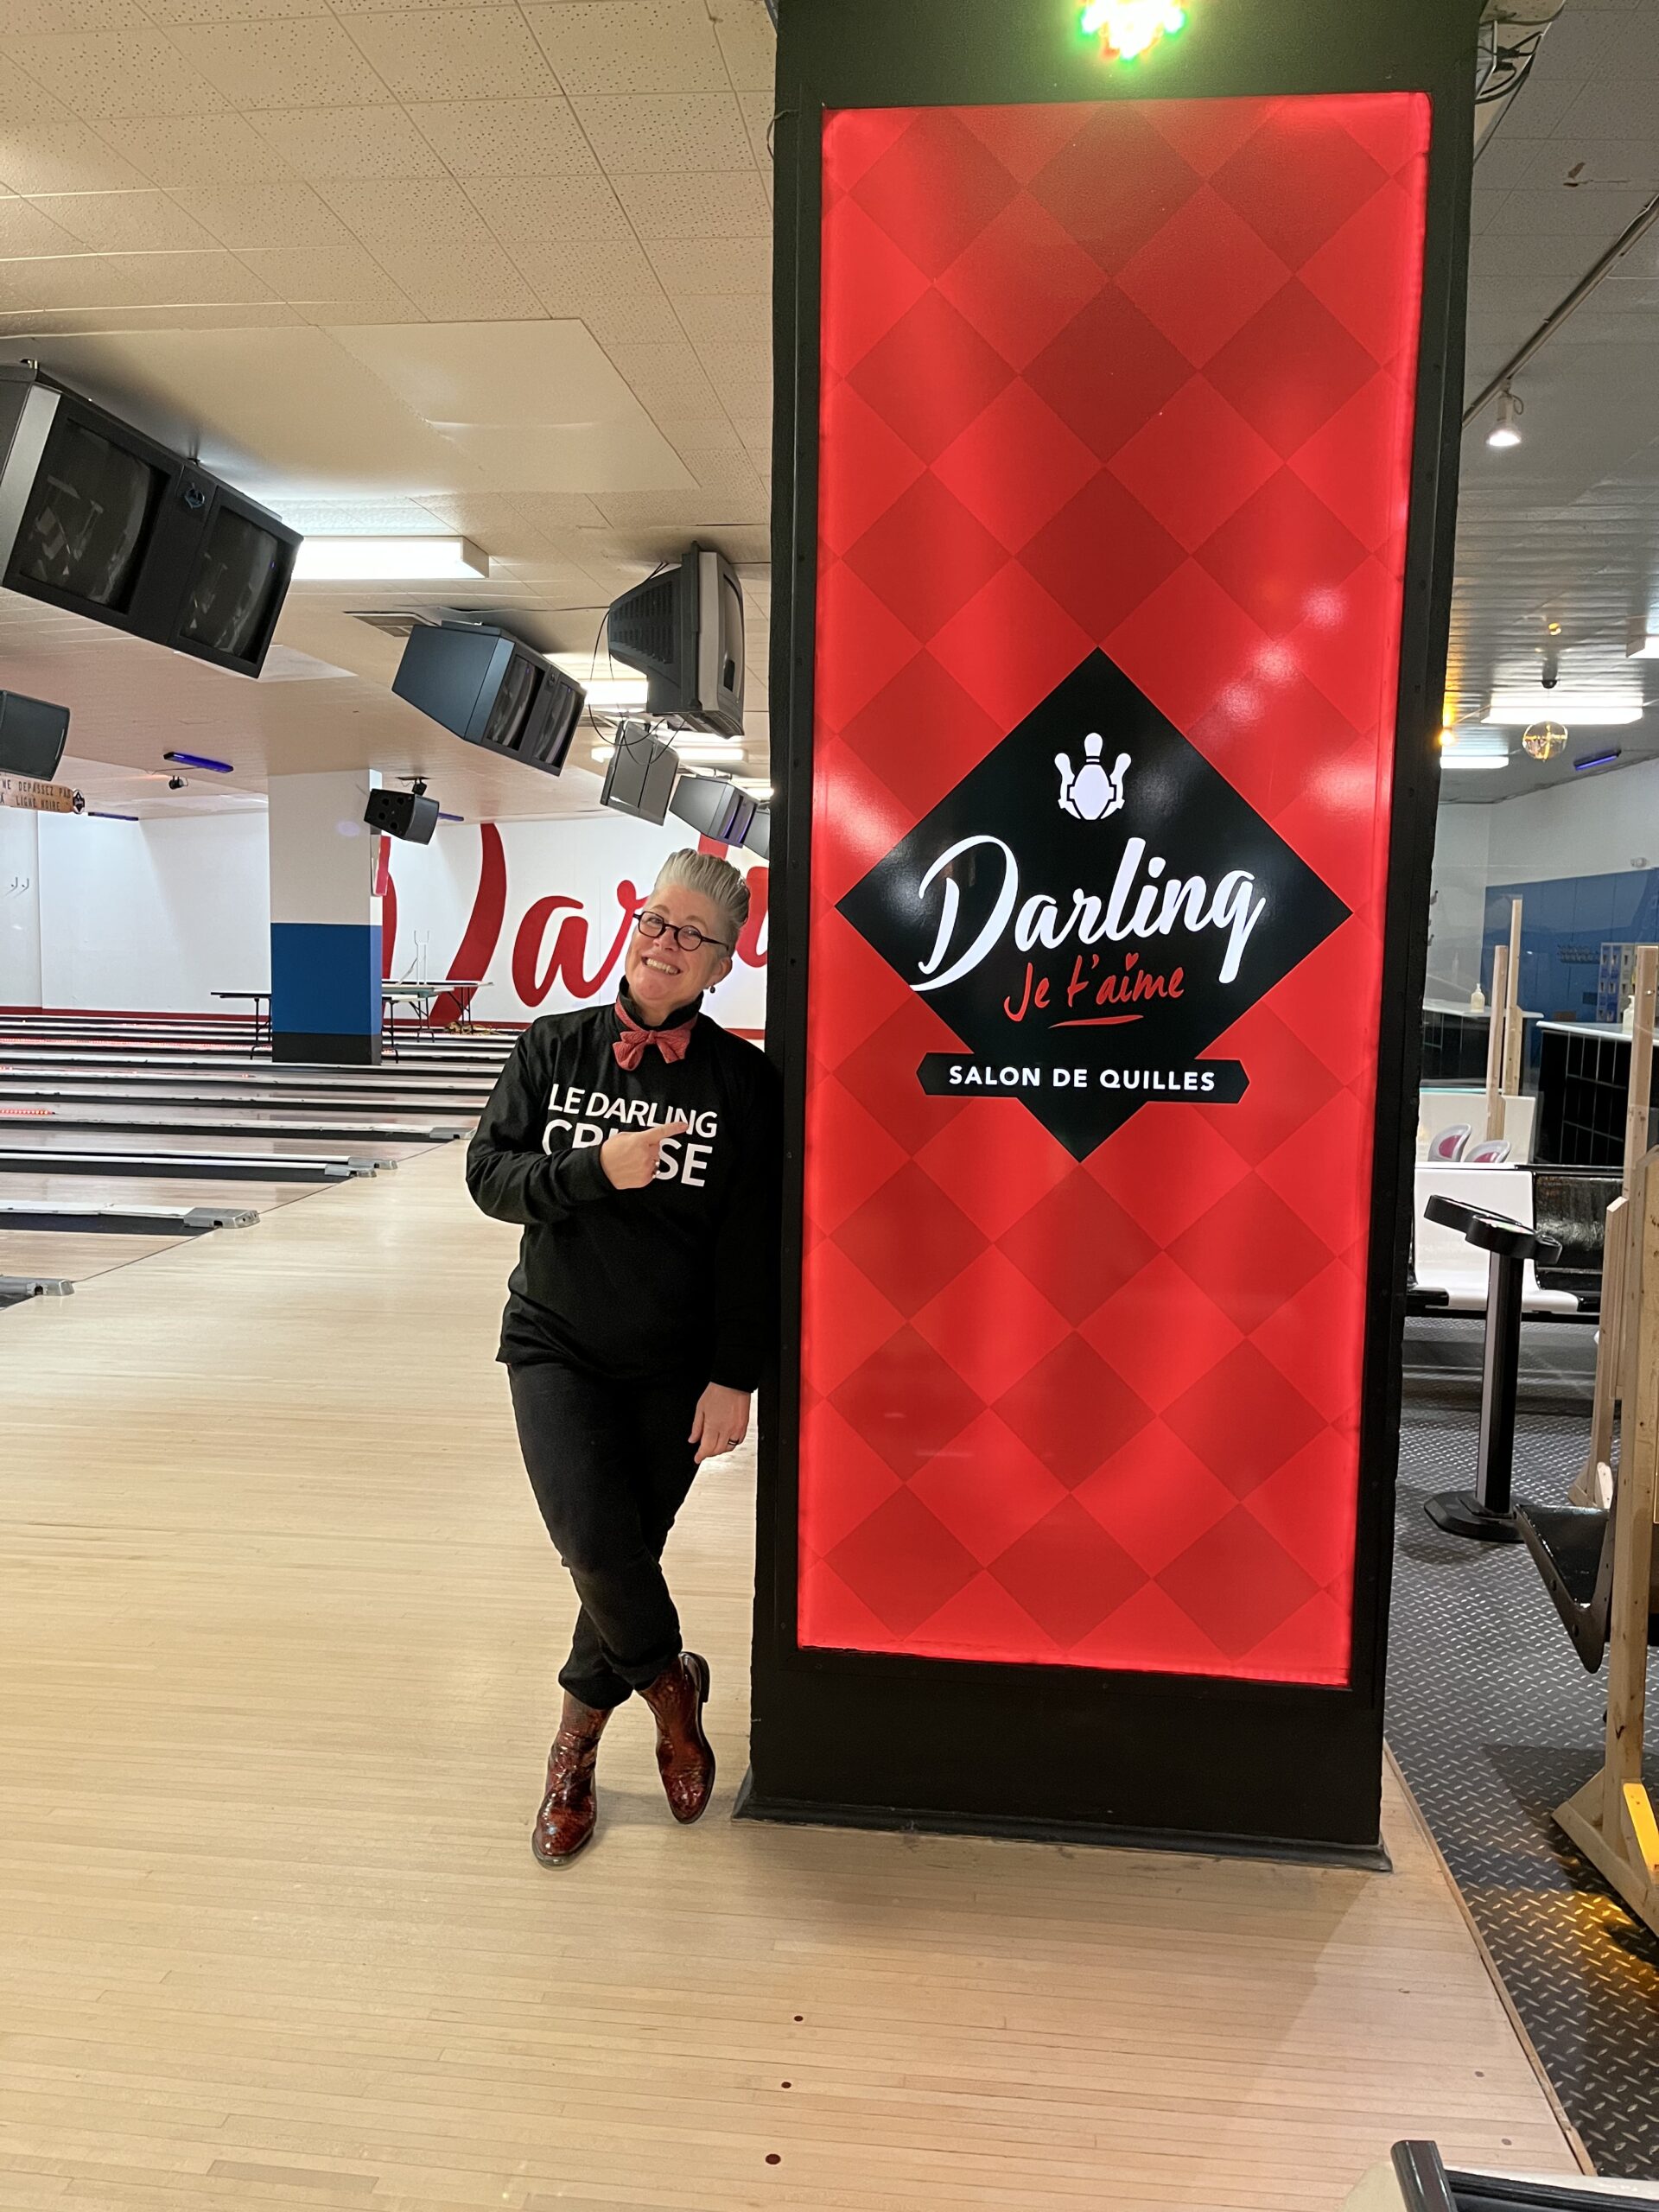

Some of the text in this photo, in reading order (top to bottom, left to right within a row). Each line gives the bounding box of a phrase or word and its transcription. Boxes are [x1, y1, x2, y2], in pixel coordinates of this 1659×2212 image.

[2, 779, 11, 790] NE
[910, 835, 1267, 992] Darling
[1004, 962, 1050, 1022] Je
[949, 1065, 1216, 1091] SALON DE QUILLES
[547, 1083, 718, 1139] LE DARLING
